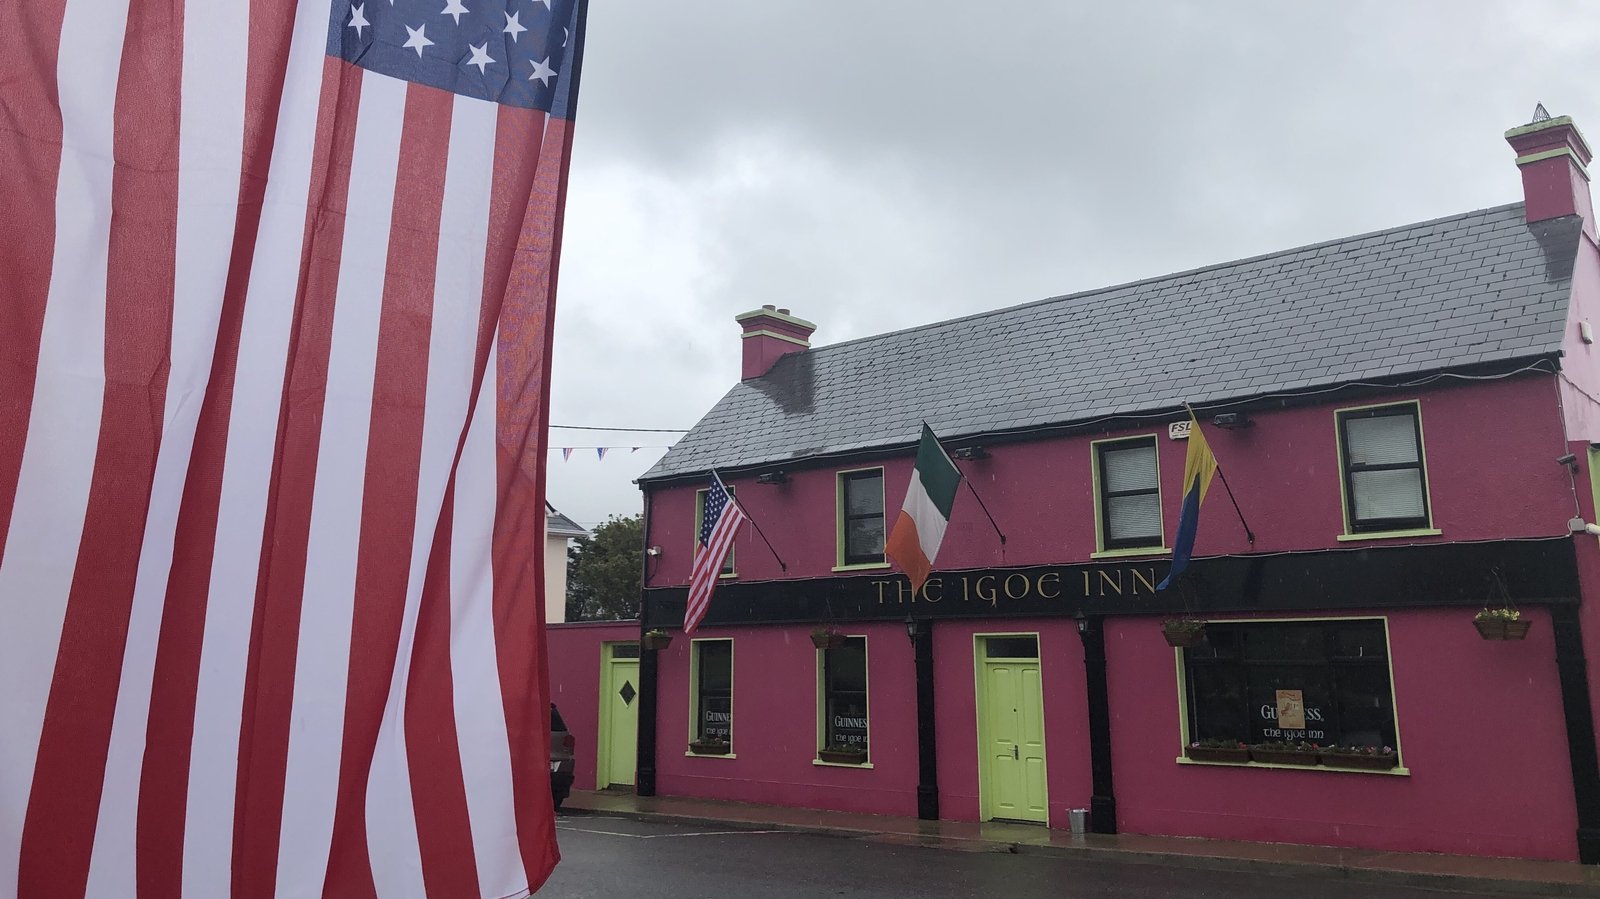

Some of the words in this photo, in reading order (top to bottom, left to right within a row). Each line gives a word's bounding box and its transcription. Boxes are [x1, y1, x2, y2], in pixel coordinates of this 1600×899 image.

[871, 578, 943, 604] THE
[962, 573, 1060, 608] IGOE
[1082, 567, 1157, 597] INN
